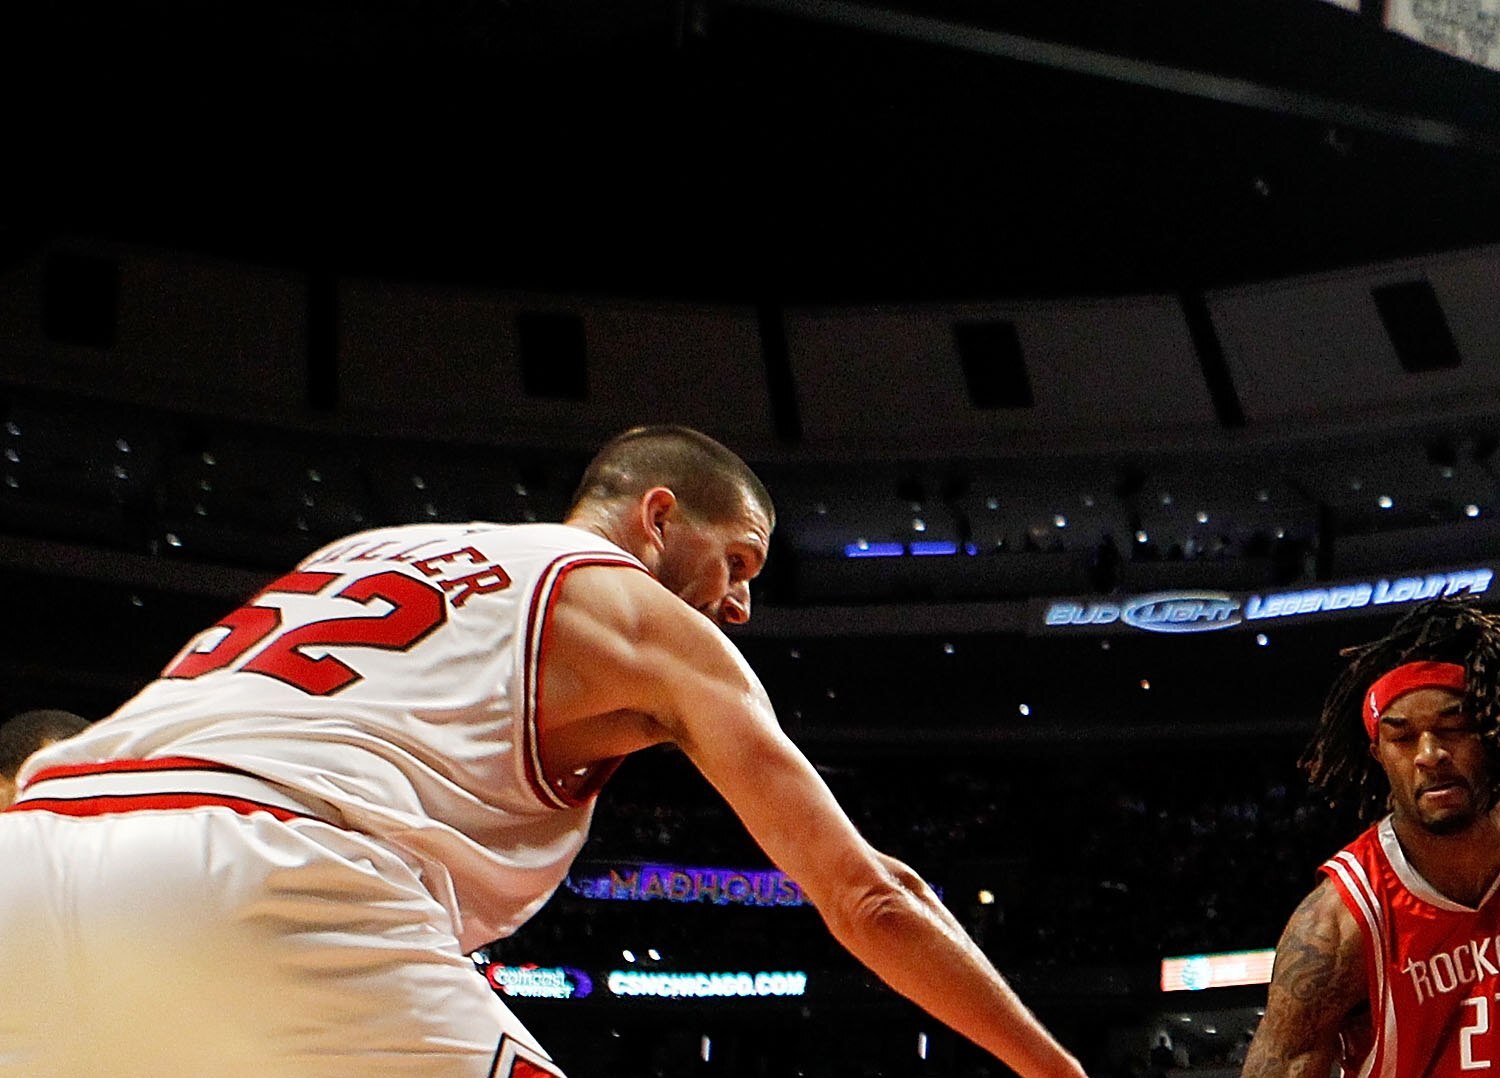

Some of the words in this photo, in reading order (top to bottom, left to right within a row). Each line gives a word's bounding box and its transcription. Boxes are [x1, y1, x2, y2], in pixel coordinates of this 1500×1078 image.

[1045, 602, 1120, 625] BUD
[1133, 602, 1240, 624] LIGHT
[1246, 583, 1372, 620] LEGENDS
[161, 571, 448, 697] 52
[610, 868, 812, 905] MADHOUS
